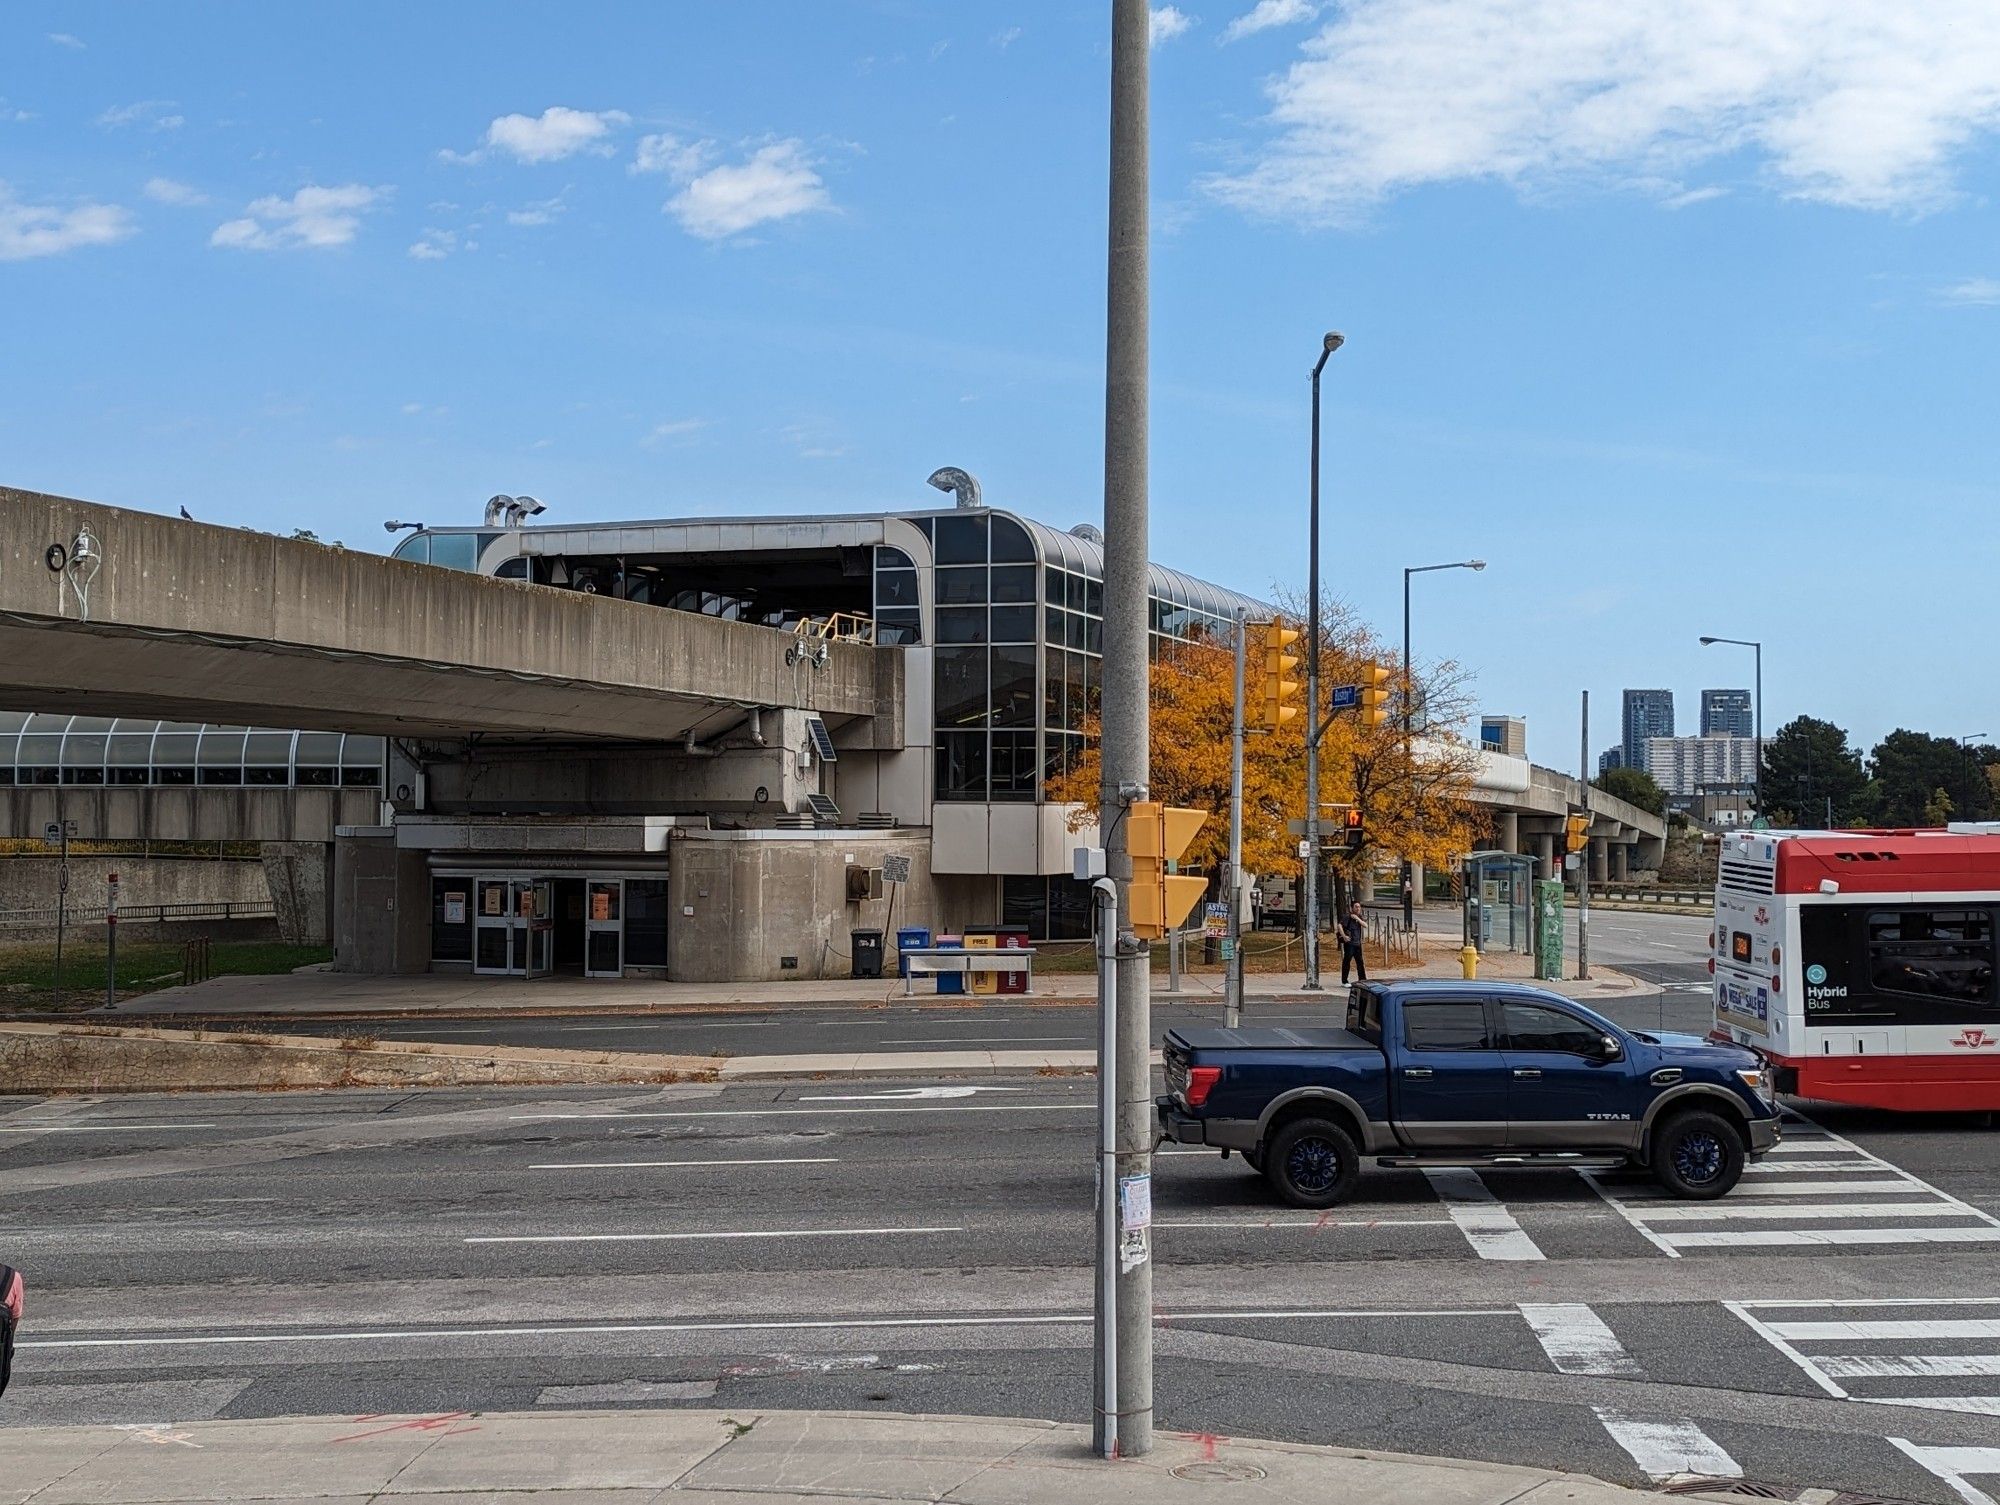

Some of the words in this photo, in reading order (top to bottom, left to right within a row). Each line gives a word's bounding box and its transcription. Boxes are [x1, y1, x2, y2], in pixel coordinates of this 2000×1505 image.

[1807, 986, 1848, 1000] Hybrid
[1808, 998, 1831, 1010] Bus
[1586, 1113, 1631, 1121] TITAN
